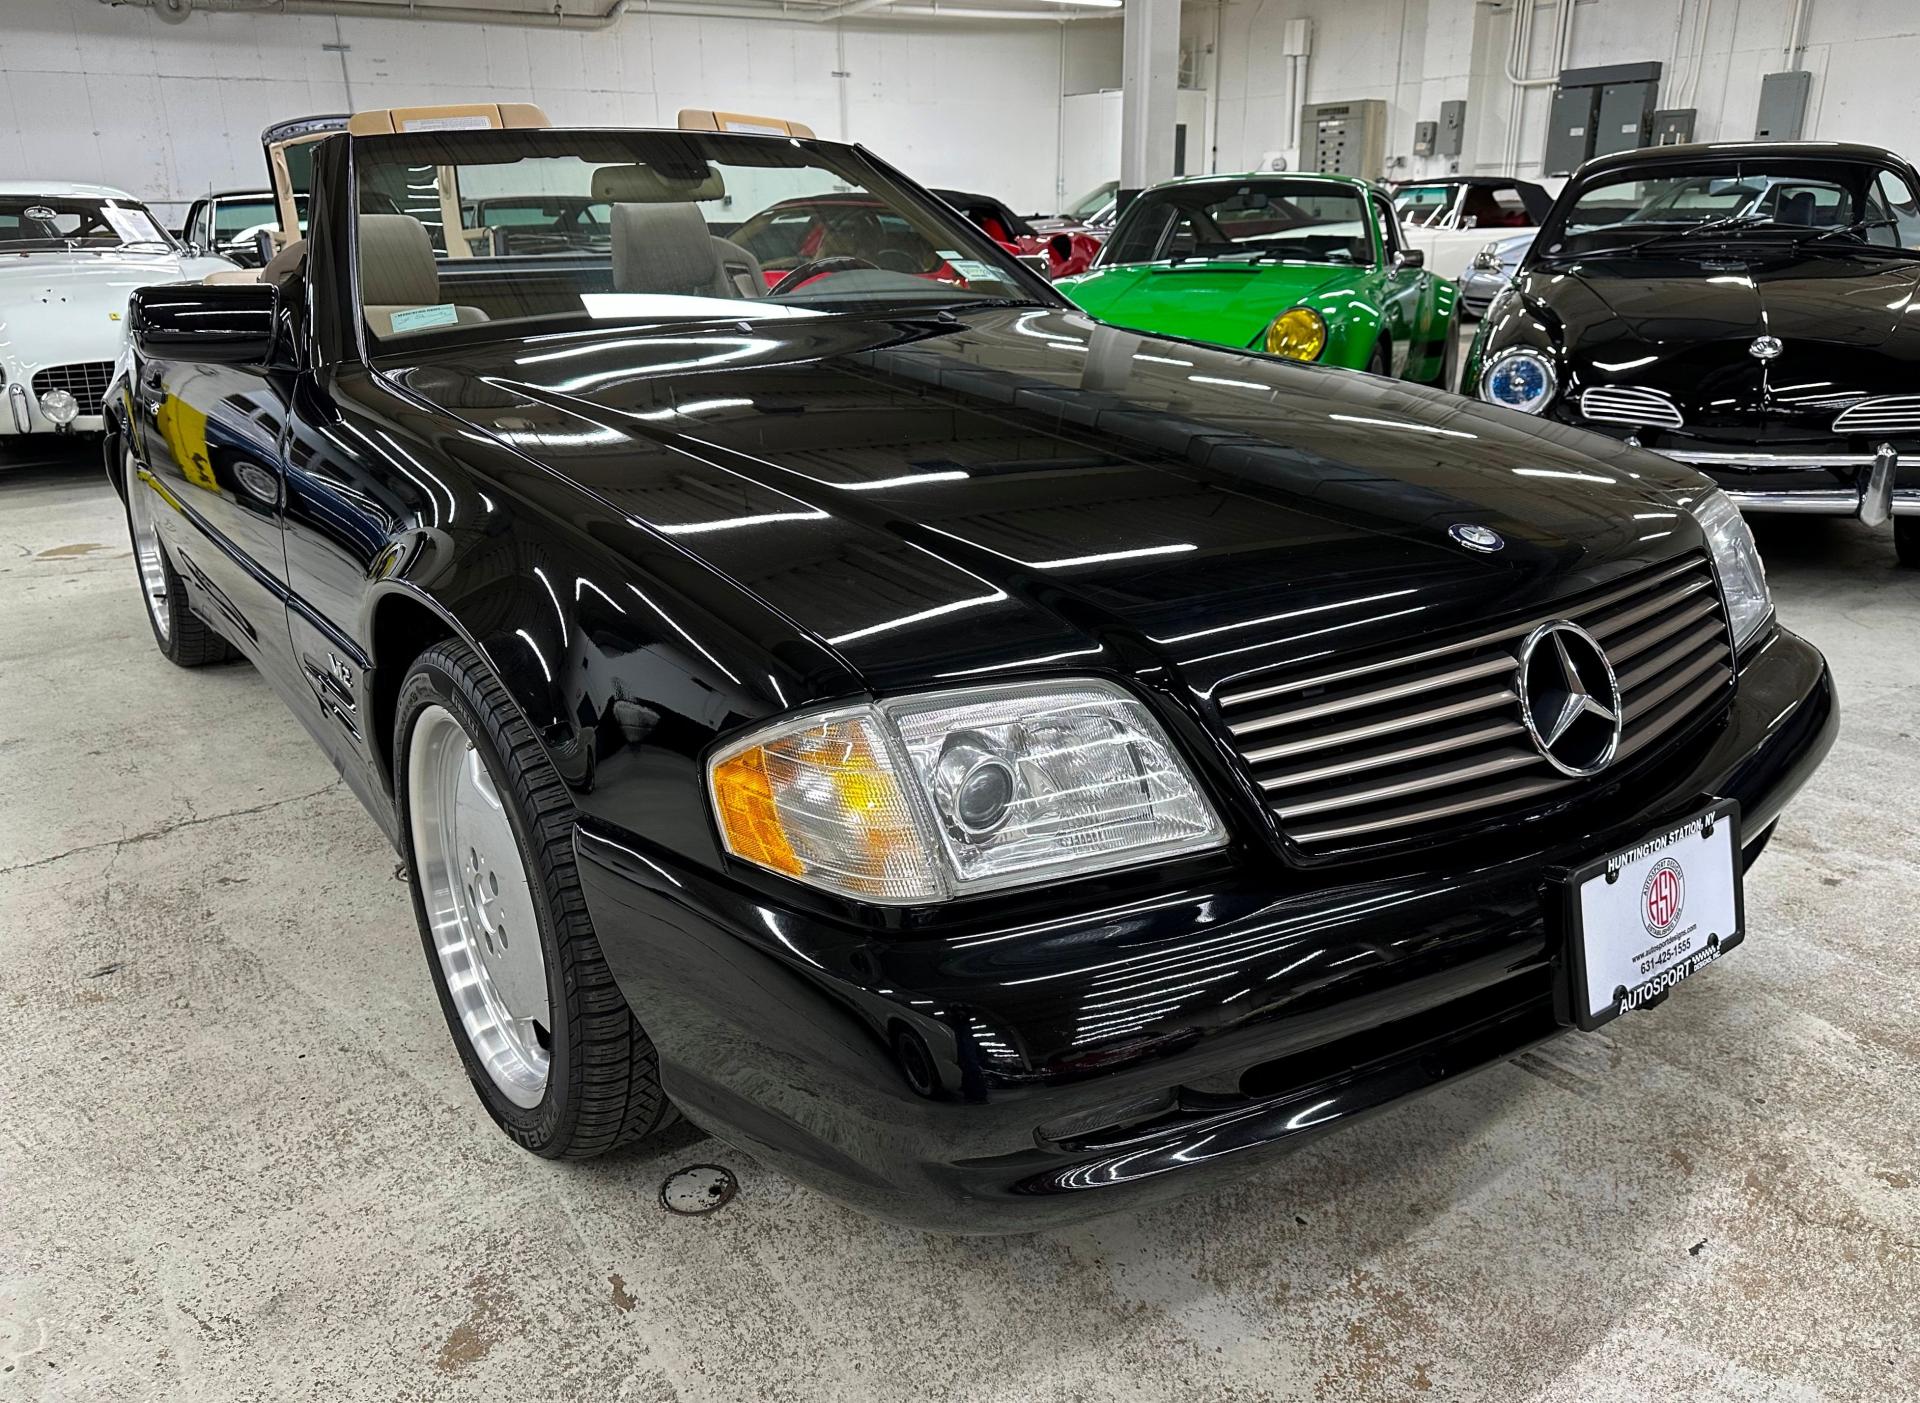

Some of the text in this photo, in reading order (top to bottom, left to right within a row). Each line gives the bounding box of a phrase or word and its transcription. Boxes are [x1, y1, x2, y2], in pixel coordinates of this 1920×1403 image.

[1608, 835, 1667, 873] HUNTINGTON
[1705, 811, 1716, 828] NY
[1643, 861, 1666, 896] AUTOSPORT
[1631, 923, 1697, 963] www.autosportdesigns.com
[1640, 938, 1691, 975] 631-425-1555
[1620, 959, 1691, 1015] AUTOSPORT
